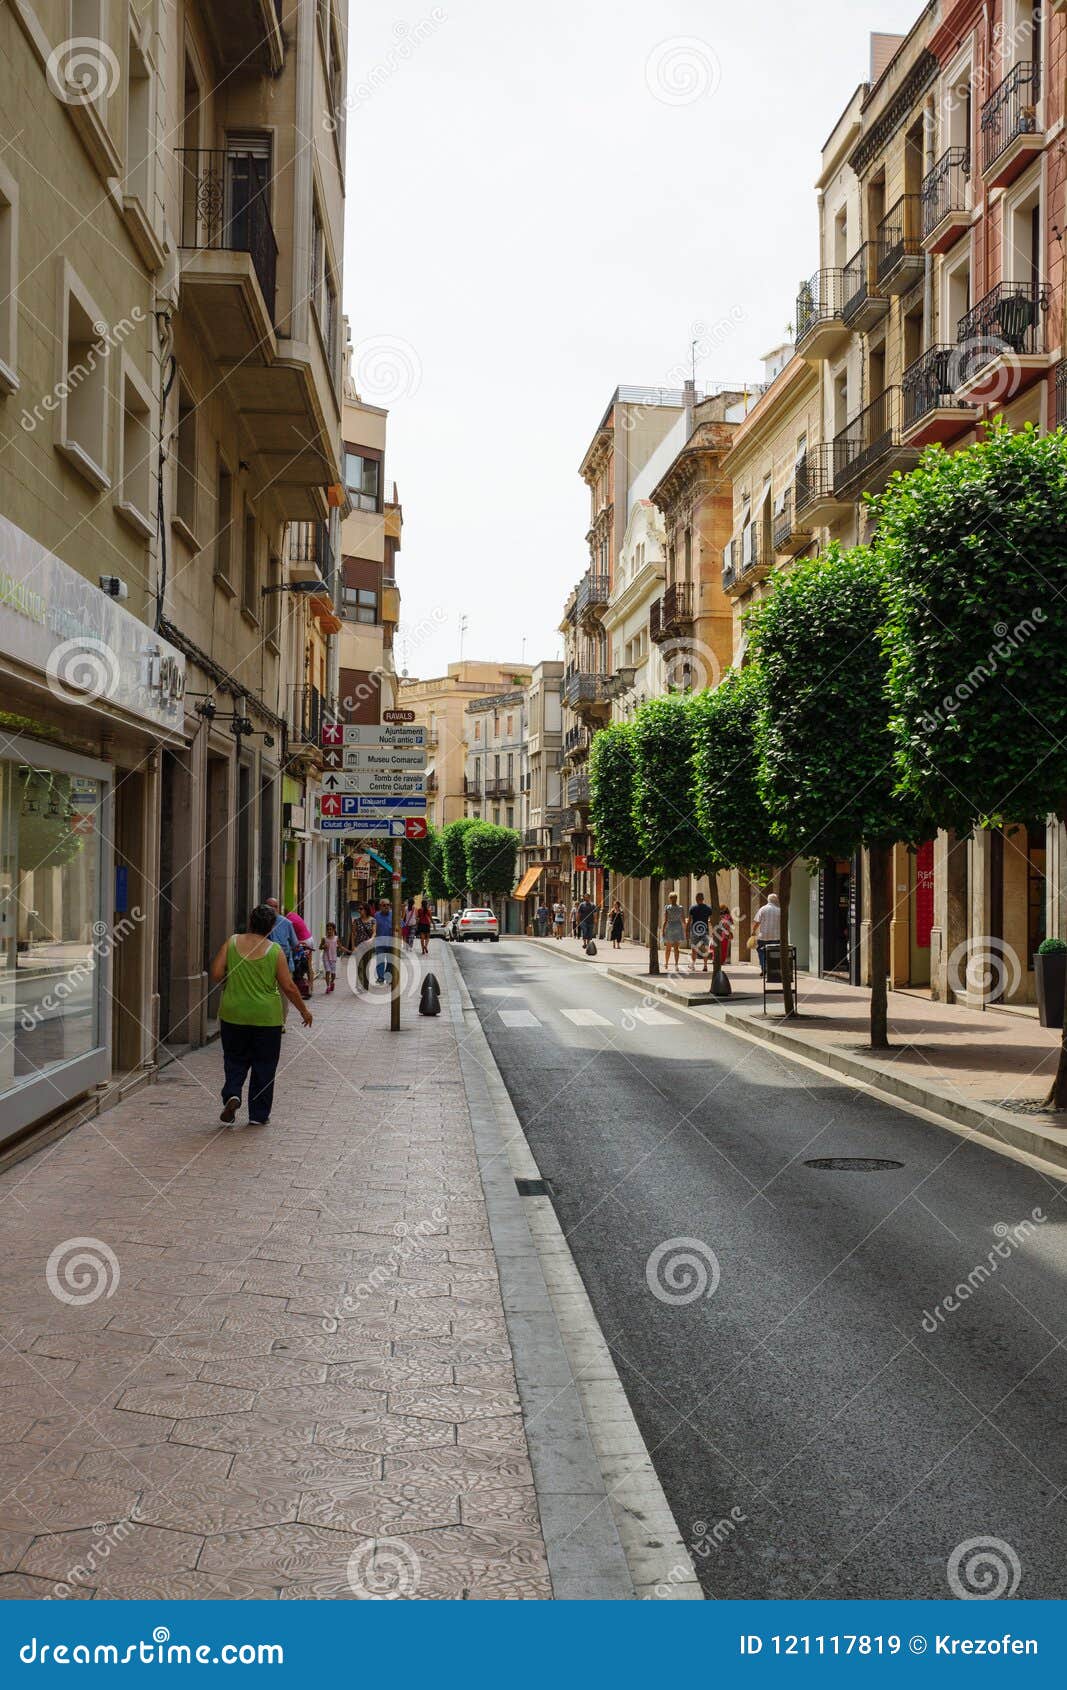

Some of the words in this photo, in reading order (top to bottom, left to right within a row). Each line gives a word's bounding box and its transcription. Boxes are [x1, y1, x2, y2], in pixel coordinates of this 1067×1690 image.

[385, 712, 413, 720] RAVALS
[385, 727, 423, 736] Ajuntament
[367, 755, 390, 763] Museu
[391, 755, 424, 763] Comarcal
[374, 774, 393, 782] Tomb
[394, 774, 402, 782] de
[369, 783, 392, 791] Centre
[393, 783, 413, 791] Ciutat
[345, 799, 355, 812] P
